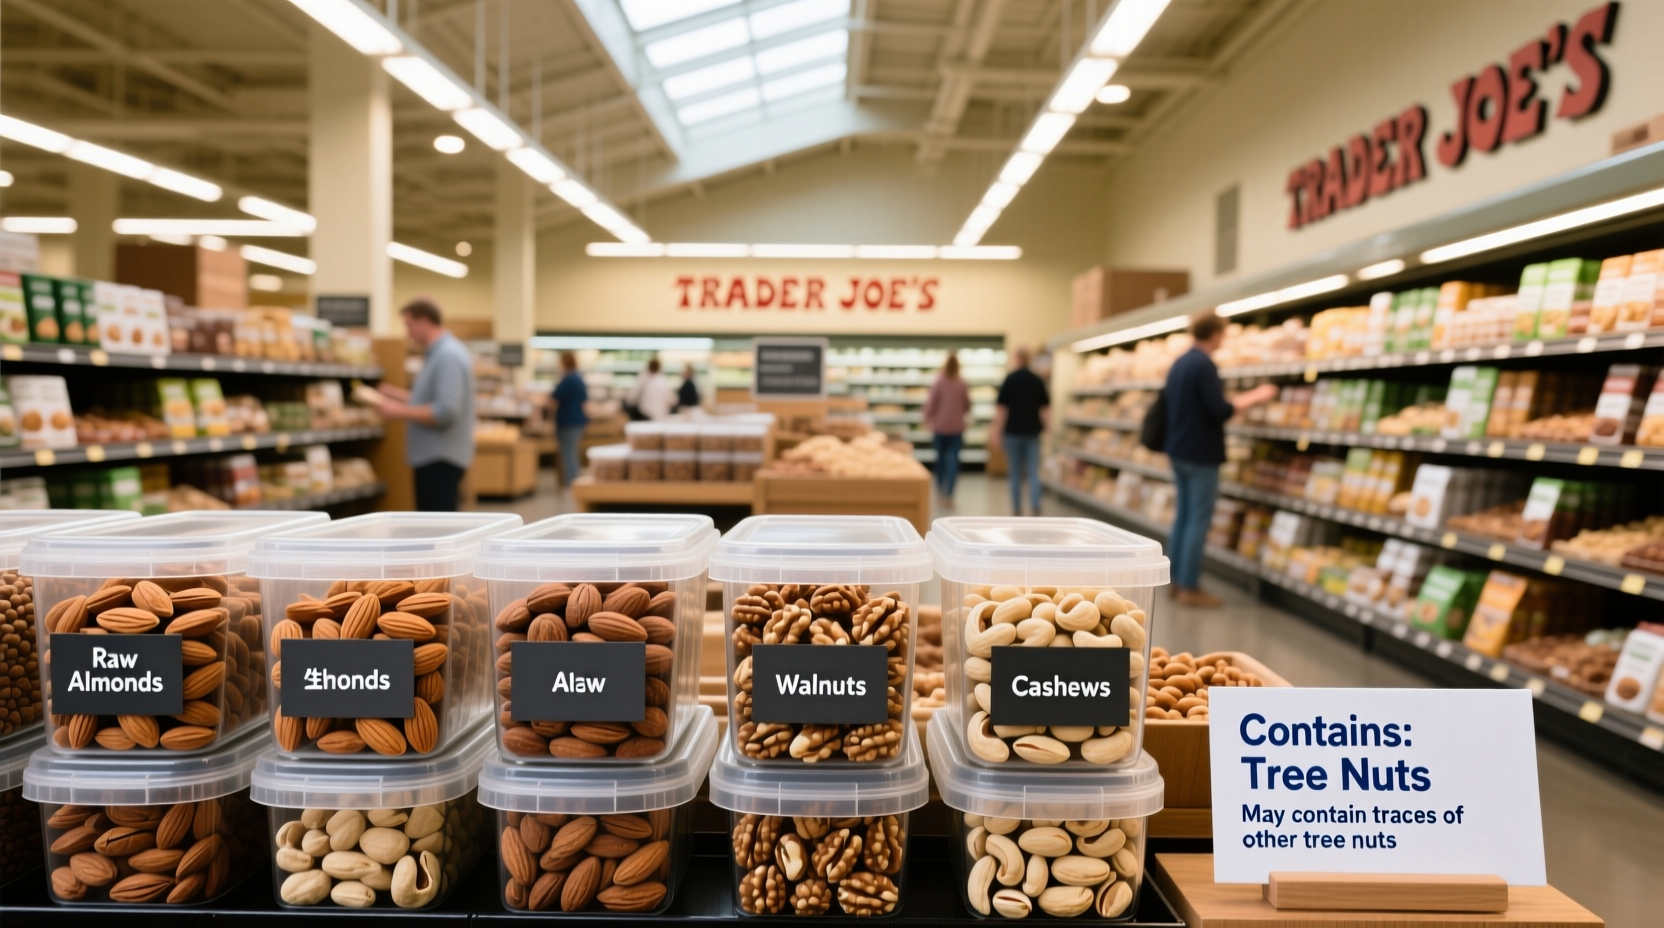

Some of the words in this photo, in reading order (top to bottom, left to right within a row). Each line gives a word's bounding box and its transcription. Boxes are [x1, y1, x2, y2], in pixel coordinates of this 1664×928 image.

[1286, 104, 1428, 231] TRADER
[1436, 1, 1621, 169] JOE'S
[675, 276, 826, 311] TRADER
[839, 277, 940, 311] JOE'S
[92, 646, 139, 669] Raw
[67, 670, 164, 693] Almonds
[775, 673, 867, 697] Walnuts
[1011, 674, 1111, 698] Cashews
[1239, 712, 1412, 748] Contains:
[1240, 756, 1328, 791] Tree
[1341, 757, 1432, 792] Nuts
[1241, 803, 1286, 828] May
[1291, 804, 1367, 824] contain
[1371, 805, 1437, 825] traces
[1442, 805, 1465, 825] of
[1242, 829, 1298, 849] other
[1302, 830, 1346, 849] tree
[1352, 831, 1397, 849] nuts
